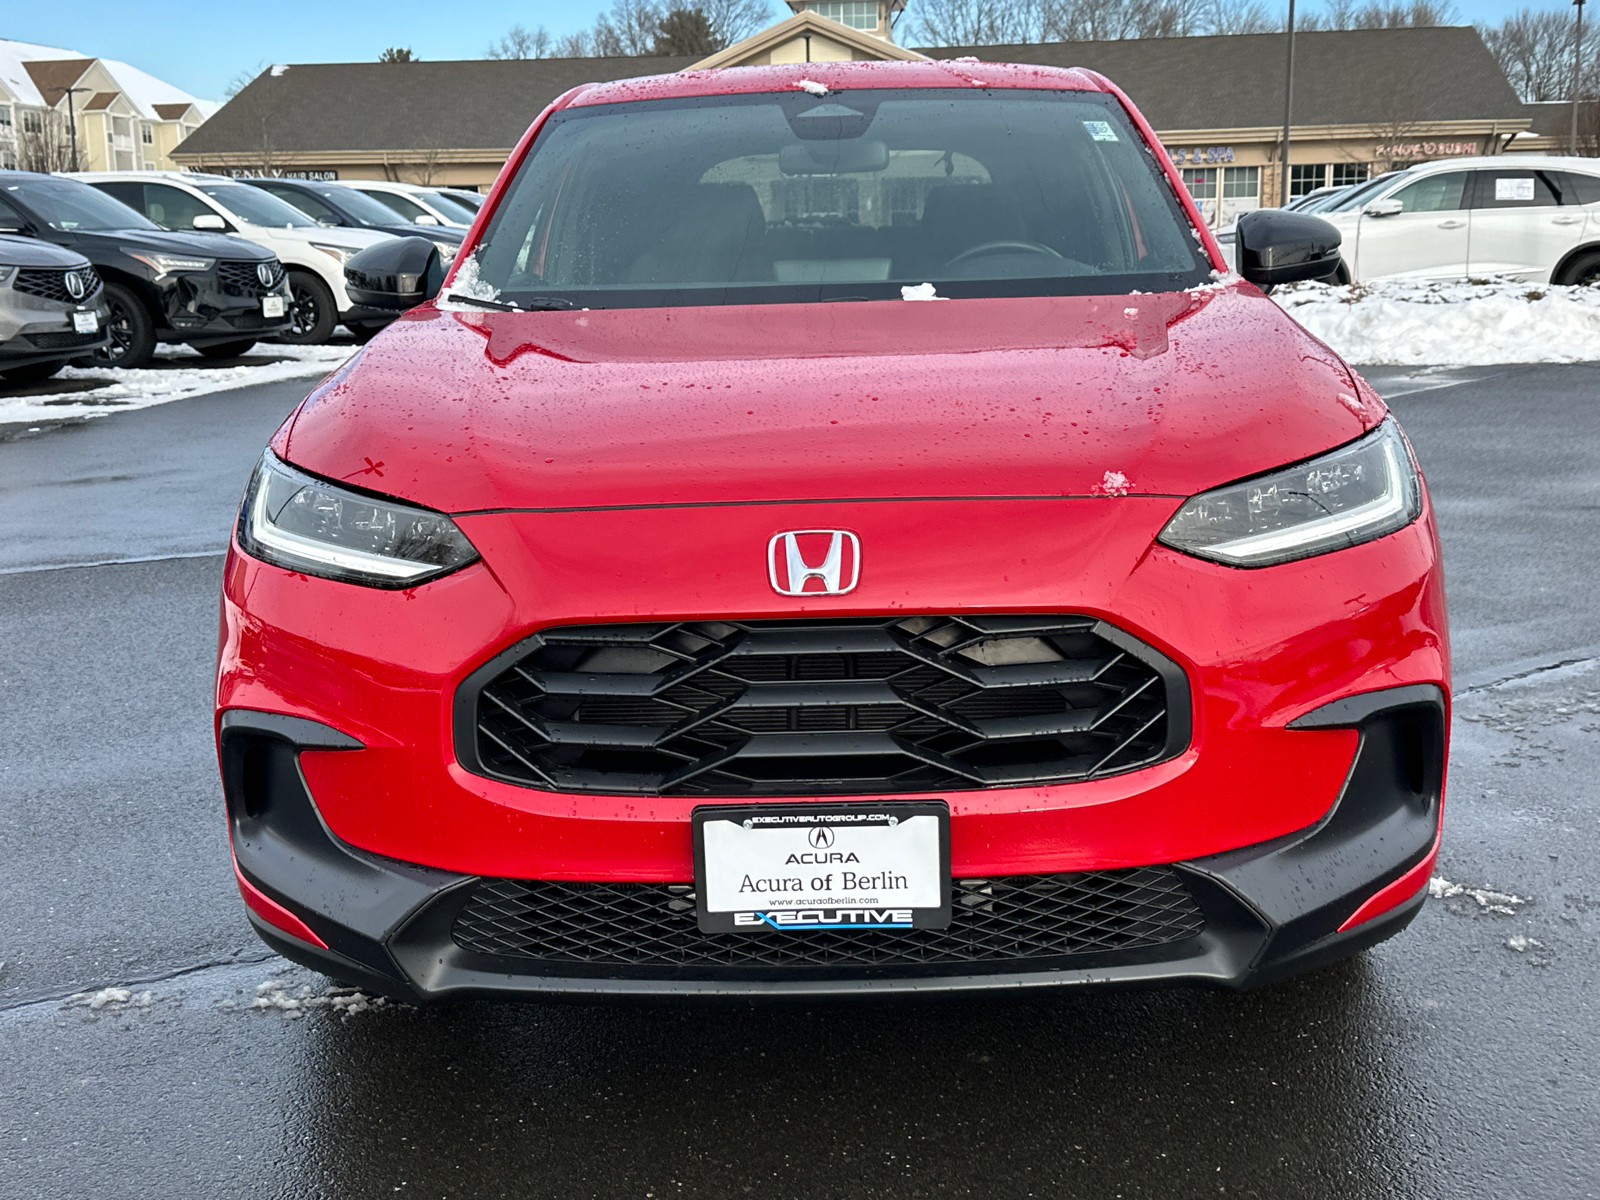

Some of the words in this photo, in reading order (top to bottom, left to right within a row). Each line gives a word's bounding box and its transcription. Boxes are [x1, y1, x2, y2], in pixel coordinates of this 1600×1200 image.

[1192, 147, 1203, 163] &
[1206, 146, 1235, 162] SPA
[286, 172, 307, 180] HAIR
[309, 171, 336, 181] SALON
[752, 814, 890, 824] EXECUTIVEAUTOGROUP.COM
[785, 852, 861, 865] ACURA
[738, 873, 804, 893] Acura
[810, 873, 834, 891] of
[842, 870, 909, 891] Berlin
[769, 896, 879, 907] www.acuraofberlin.com
[734, 909, 914, 927] EXECUTIVE
